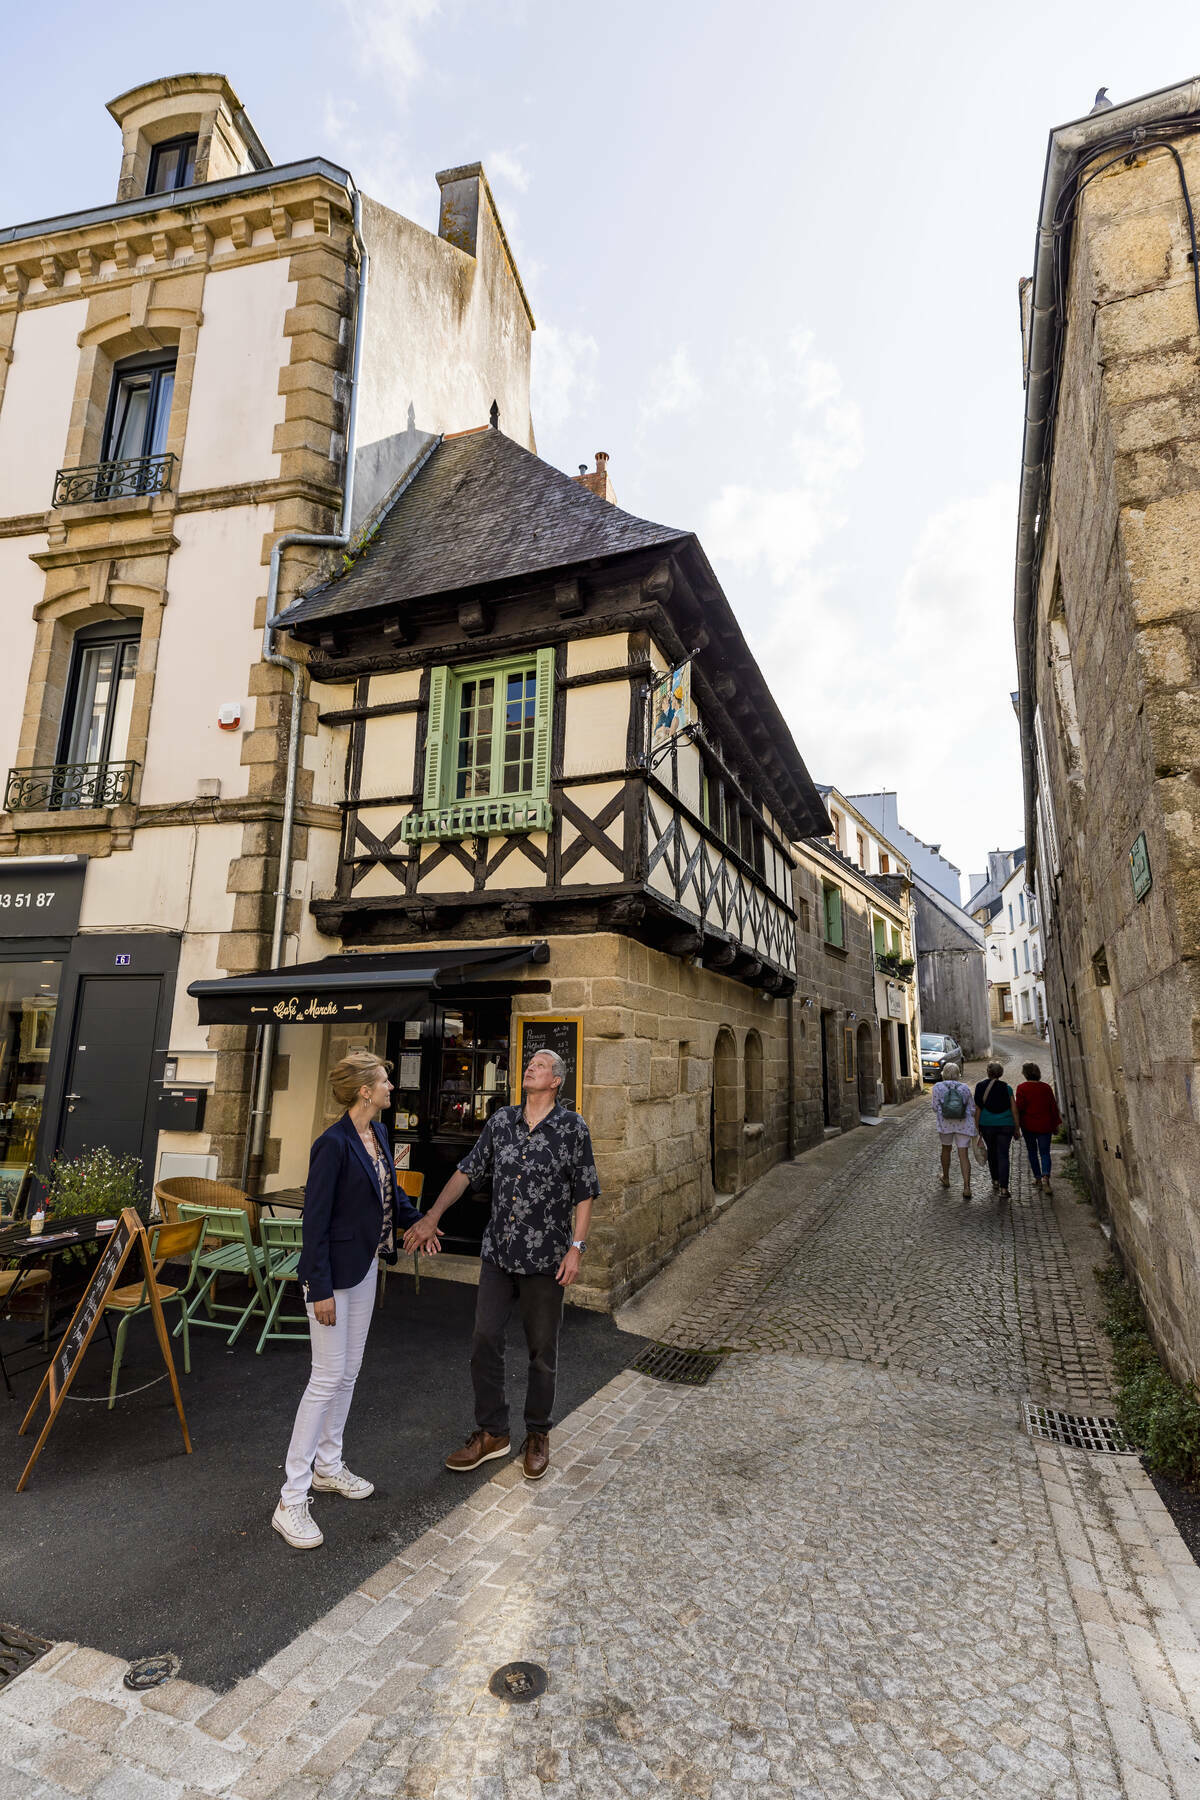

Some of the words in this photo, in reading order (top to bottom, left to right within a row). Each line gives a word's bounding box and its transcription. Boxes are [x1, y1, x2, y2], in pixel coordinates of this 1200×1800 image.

[15, 893, 31, 907] 51
[36, 892, 55, 907] 87
[120, 955, 126, 965] 6
[273, 997, 298, 1020] Café
[296, 1011, 304, 1020] du
[304, 998, 338, 1018] Marché
